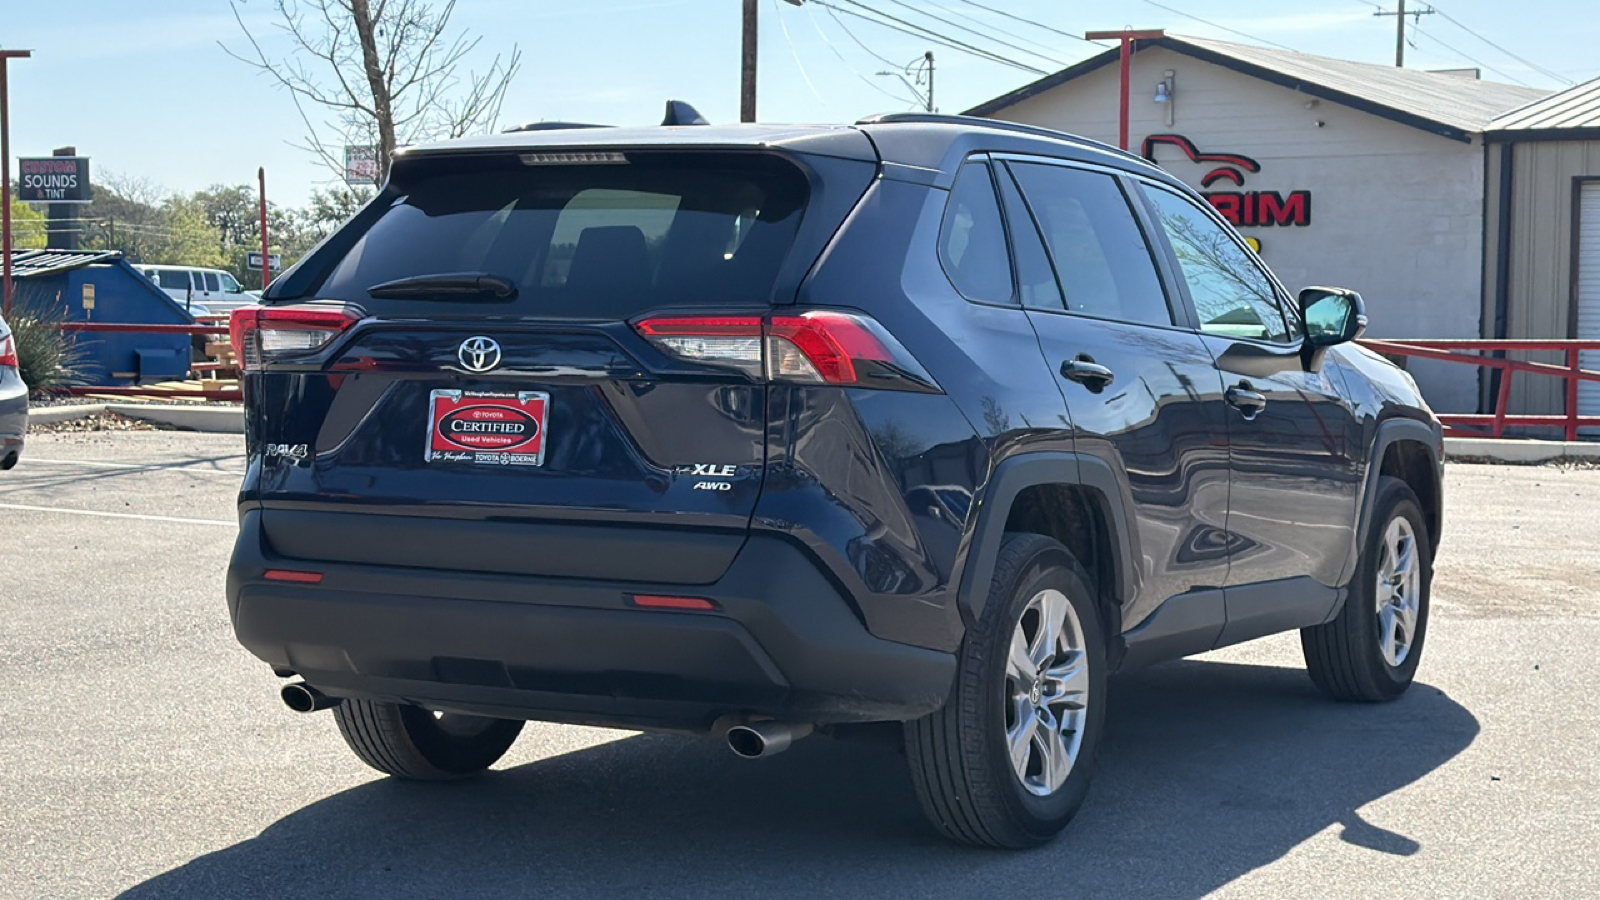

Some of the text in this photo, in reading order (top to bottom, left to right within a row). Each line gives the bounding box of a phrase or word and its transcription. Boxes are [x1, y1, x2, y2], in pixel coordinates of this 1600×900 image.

[23, 161, 77, 173] CUSTOM
[25, 175, 77, 188] SOUNDS
[45, 189, 65, 199] TINT
[1200, 190, 1311, 226] RIM
[451, 420, 525, 433] CERTIFIED
[461, 435, 512, 444] Used Vehicles
[265, 443, 308, 458] RAV4
[510, 455, 537, 463] BOERNE
[691, 463, 737, 477] XLE
[693, 481, 731, 491] AWD
